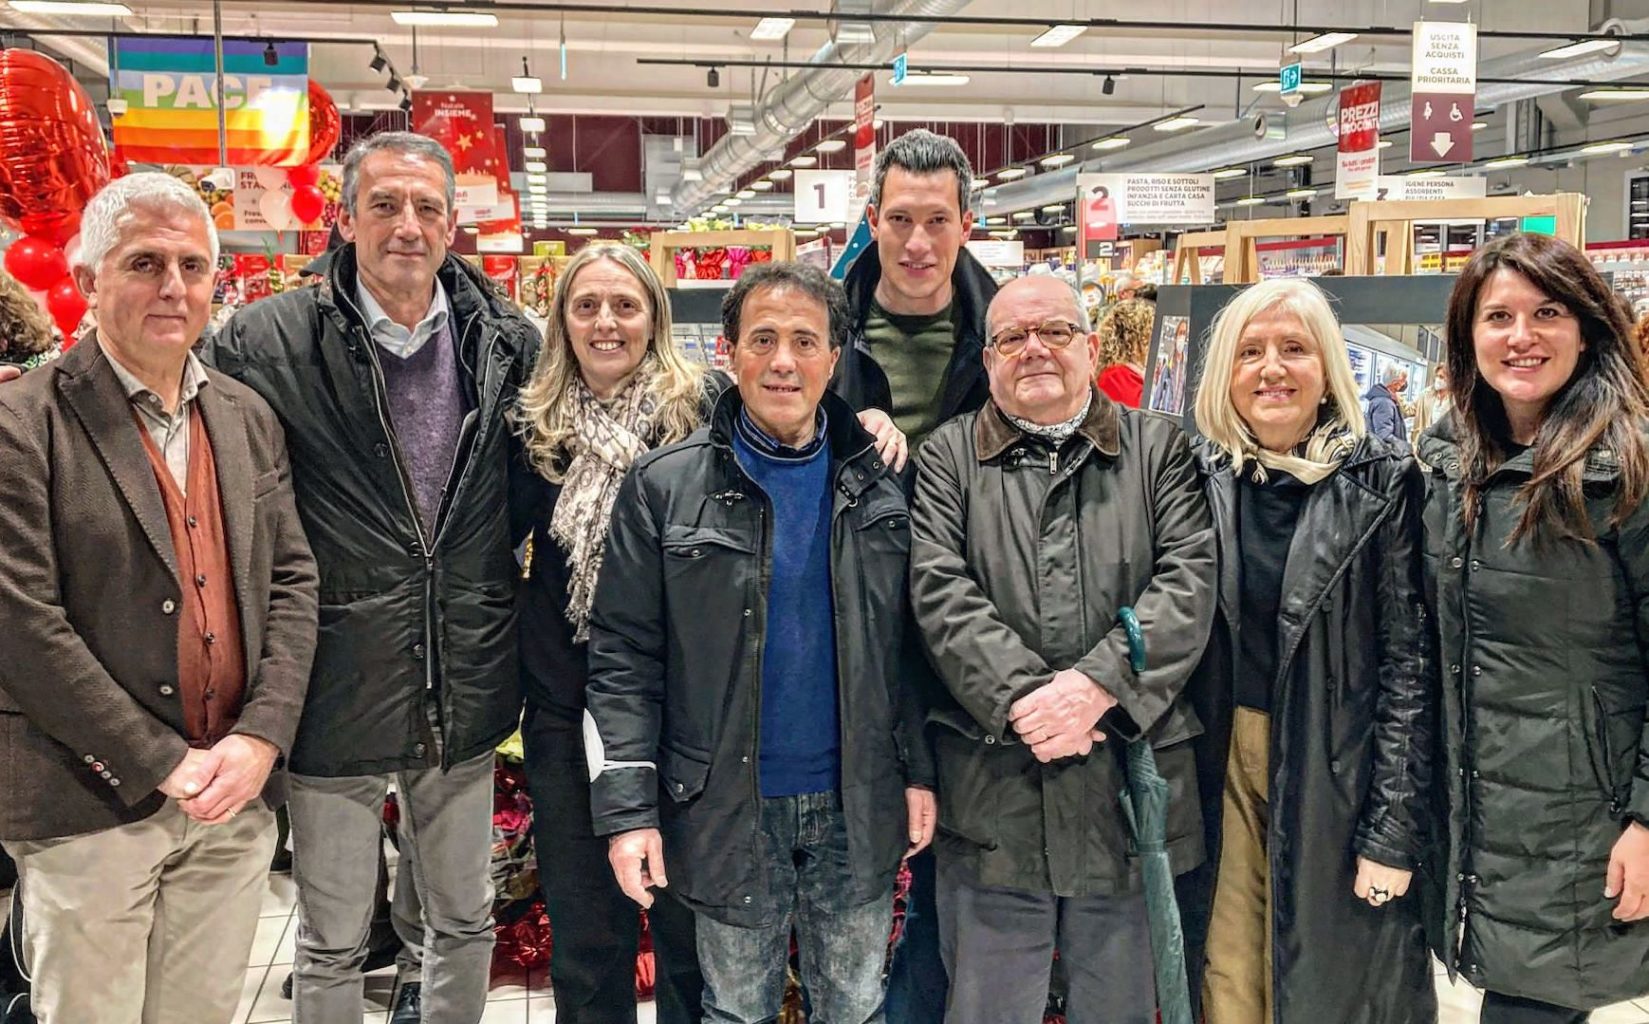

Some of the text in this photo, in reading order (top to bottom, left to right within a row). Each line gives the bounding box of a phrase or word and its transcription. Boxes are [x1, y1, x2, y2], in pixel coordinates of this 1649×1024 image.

[1431, 42, 1459, 50] SENZA
[1425, 51, 1464, 59] ACQUISTI
[1430, 67, 1458, 75] CASSA
[1417, 75, 1470, 84] PRIORITARIA
[1341, 101, 1379, 121] PREZZI
[1127, 178, 1150, 186] PASTA,
[813, 183, 825, 209] 1
[1091, 186, 1109, 211] 2
